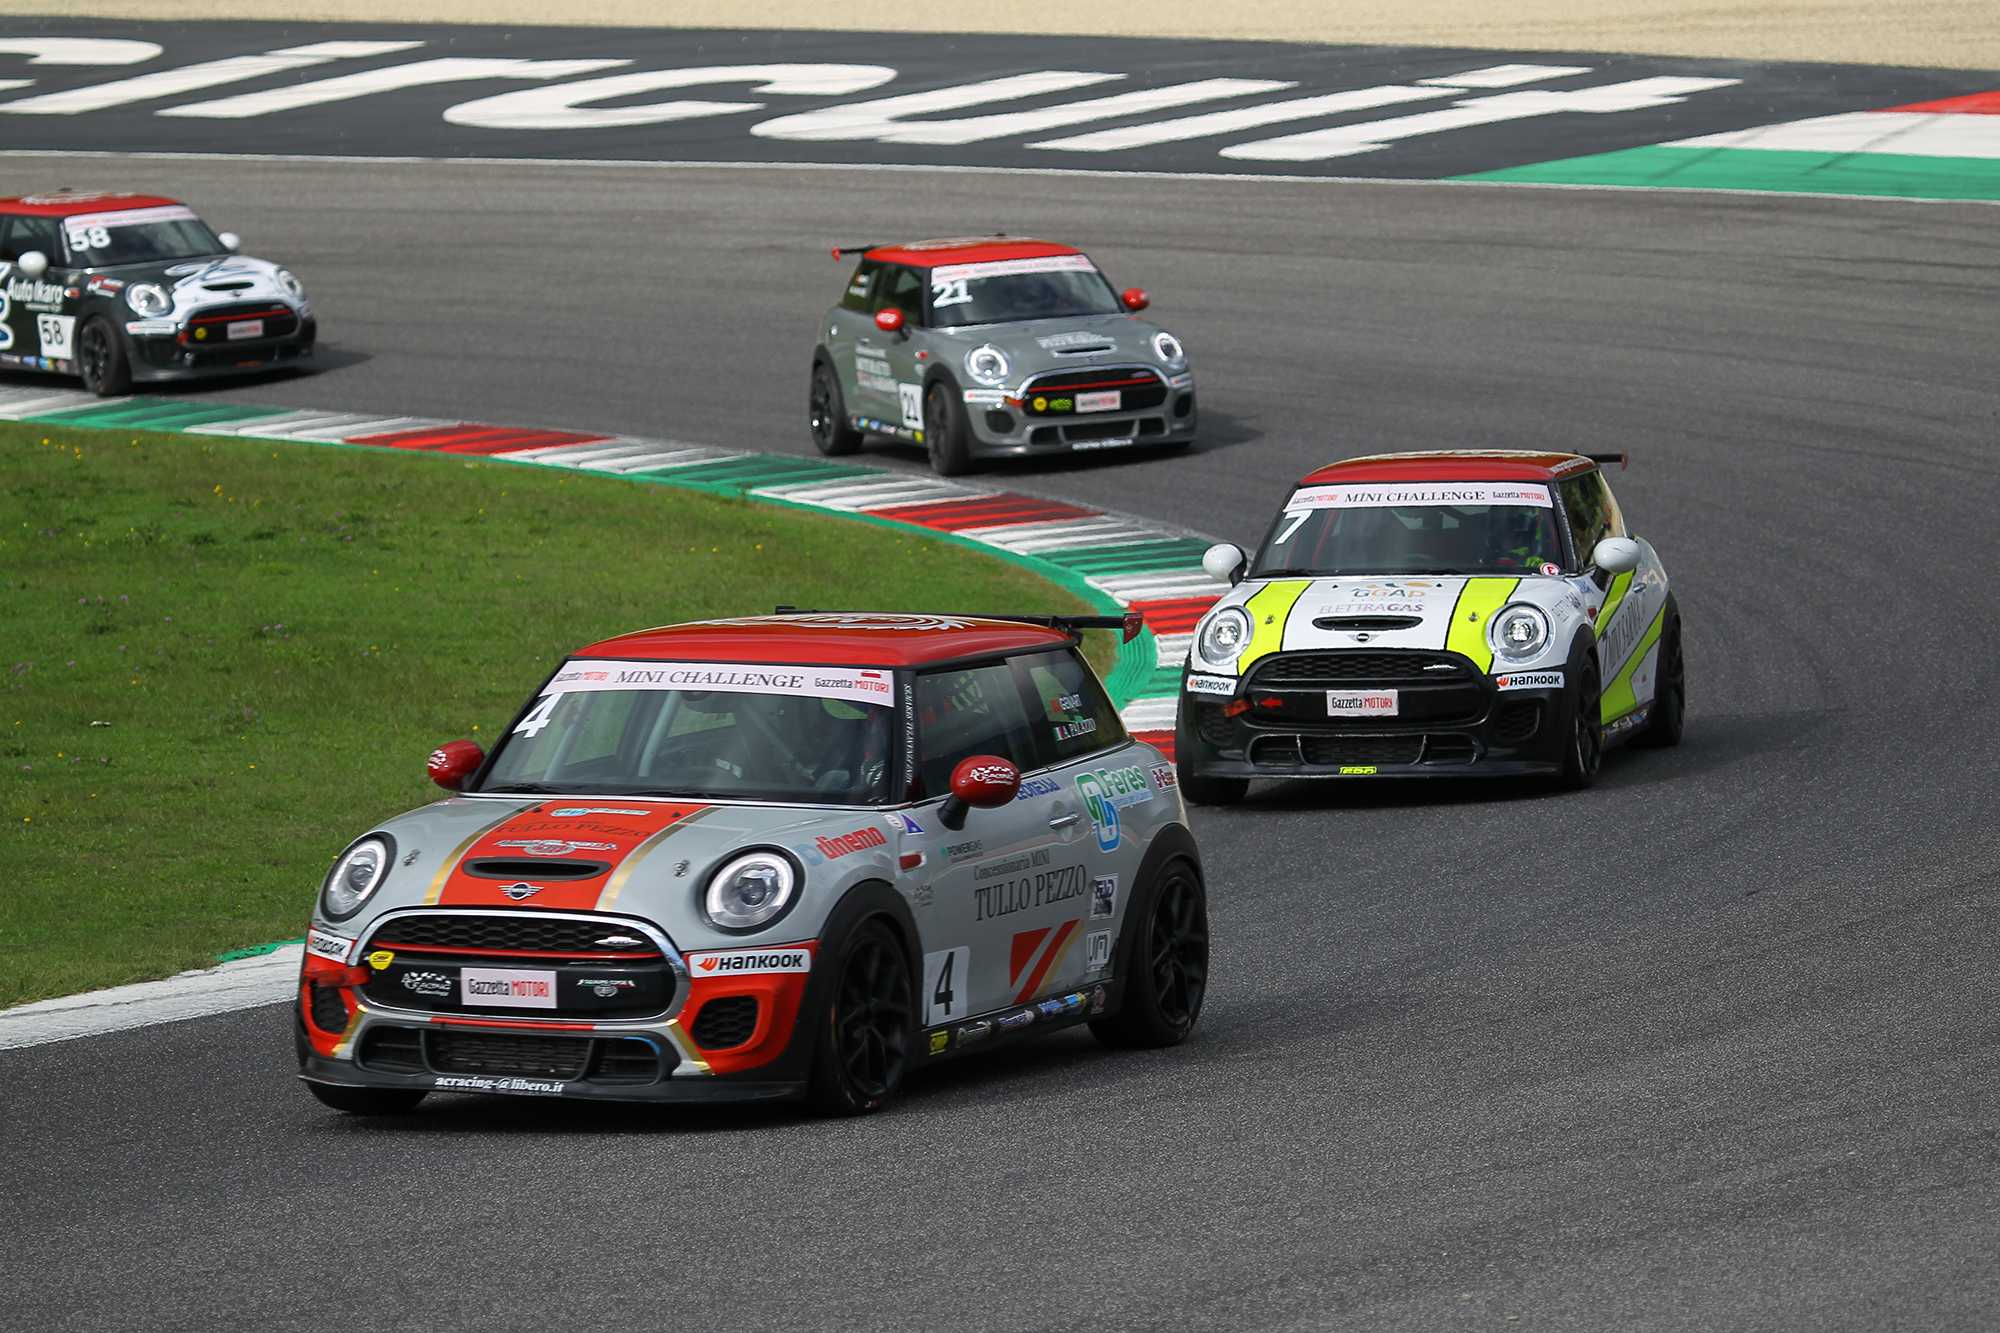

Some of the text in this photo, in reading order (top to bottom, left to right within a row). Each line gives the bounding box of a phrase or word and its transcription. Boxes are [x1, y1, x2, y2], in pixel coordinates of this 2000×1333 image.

[69, 225, 112, 252] 58
[931, 279, 974, 309] 21
[41, 320, 64, 345] 58
[903, 390, 919, 422] 21
[1344, 491, 1486, 503] MINI CHALLENGE
[1274, 509, 1314, 545] 7
[1319, 603, 1425, 615] ELETTRAGAS
[614, 671, 804, 689] MINI CHALLENGE
[815, 678, 890, 693] Gazzetta MOTORI
[512, 692, 563, 738] 4
[1332, 696, 1393, 709] Gazzetta MOTORI
[974, 877, 1031, 922] TULLO
[1034, 863, 1087, 908] PEZZO
[468, 977, 549, 998] Gazzetta MOTORI
[934, 951, 954, 1016] 4
